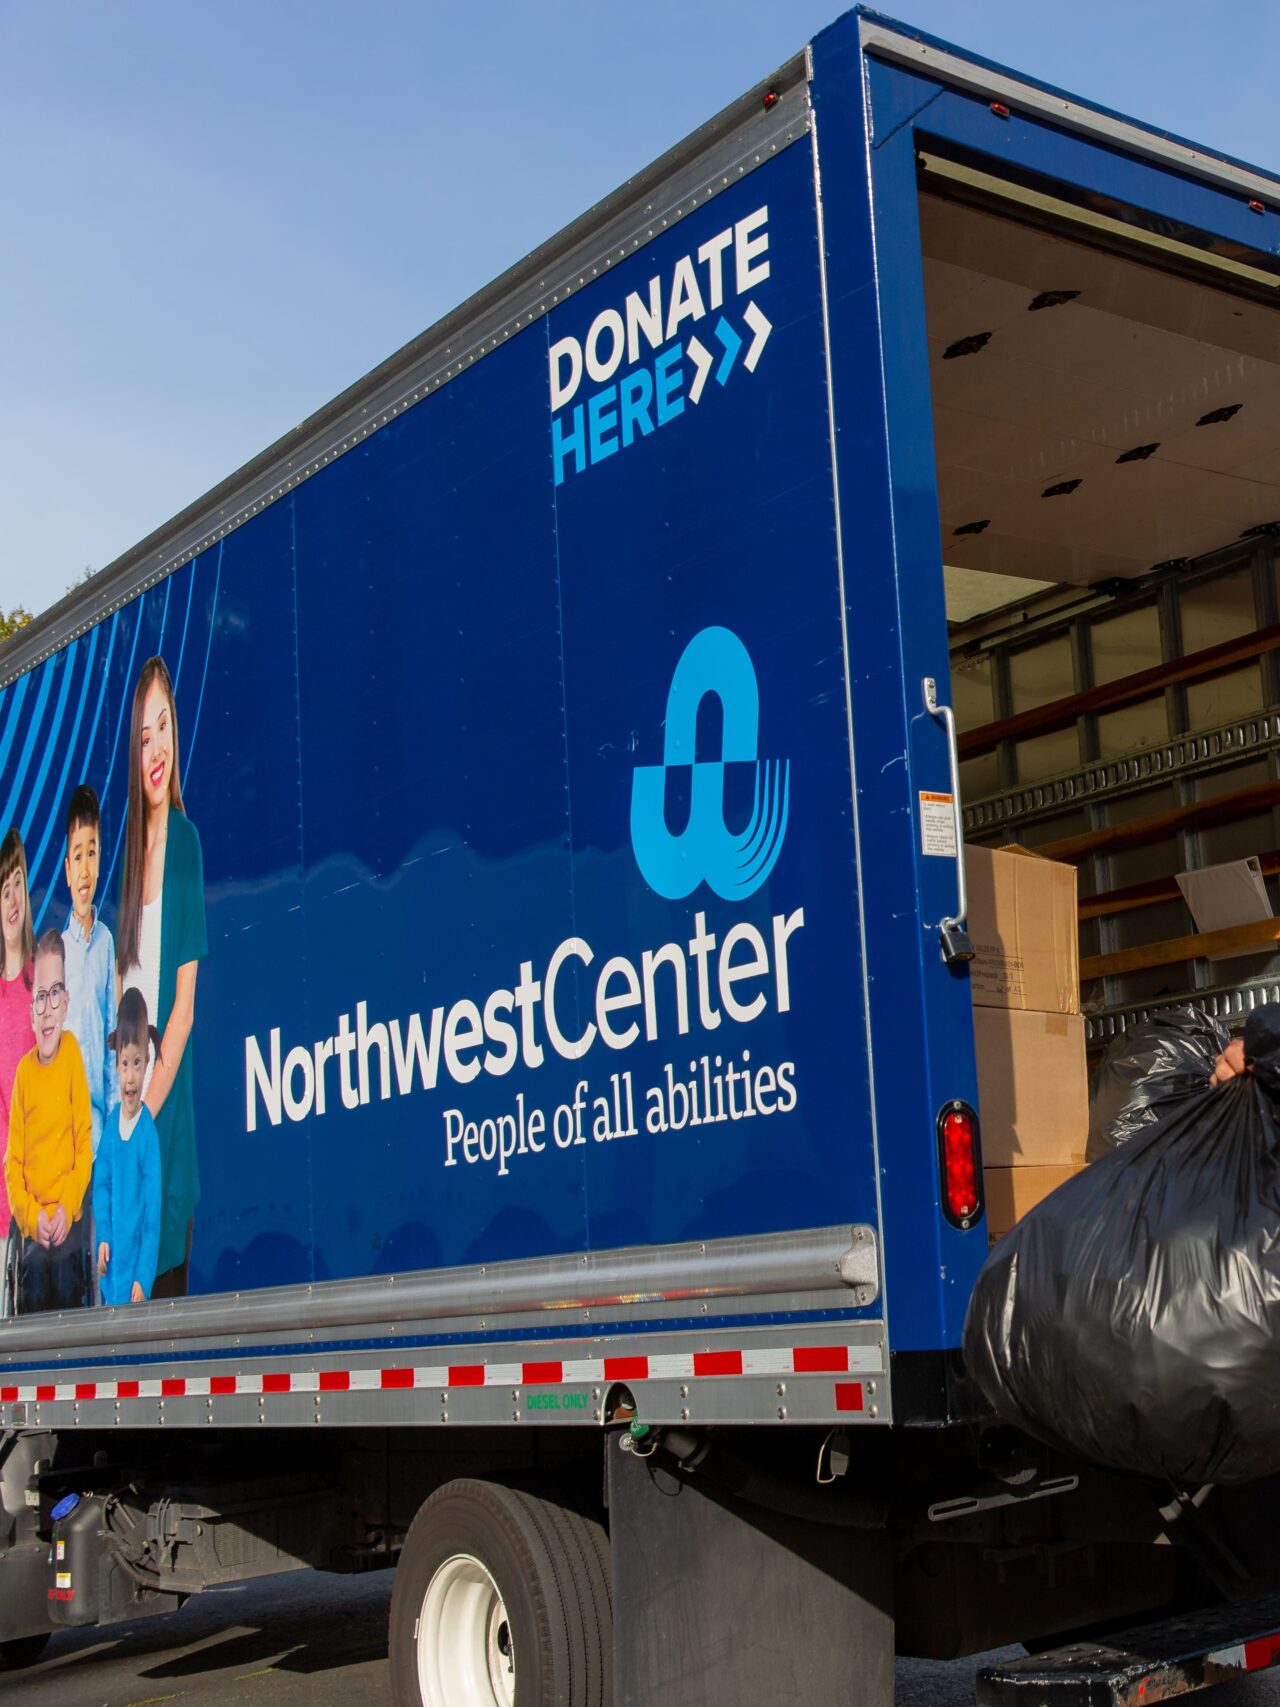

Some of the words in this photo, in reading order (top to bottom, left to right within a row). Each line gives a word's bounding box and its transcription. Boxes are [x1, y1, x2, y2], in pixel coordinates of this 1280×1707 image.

[549, 205, 770, 413] DONATE
[552, 342, 685, 487] HERE
[245, 907, 804, 1132] NorthwestCenter
[443, 1092, 546, 1176] People
[553, 1080, 588, 1148] of
[593, 1071, 638, 1142] all
[646, 1049, 797, 1134] abilities
[527, 1394, 560, 1410] DIESEL
[562, 1392, 588, 1409] ONLY
